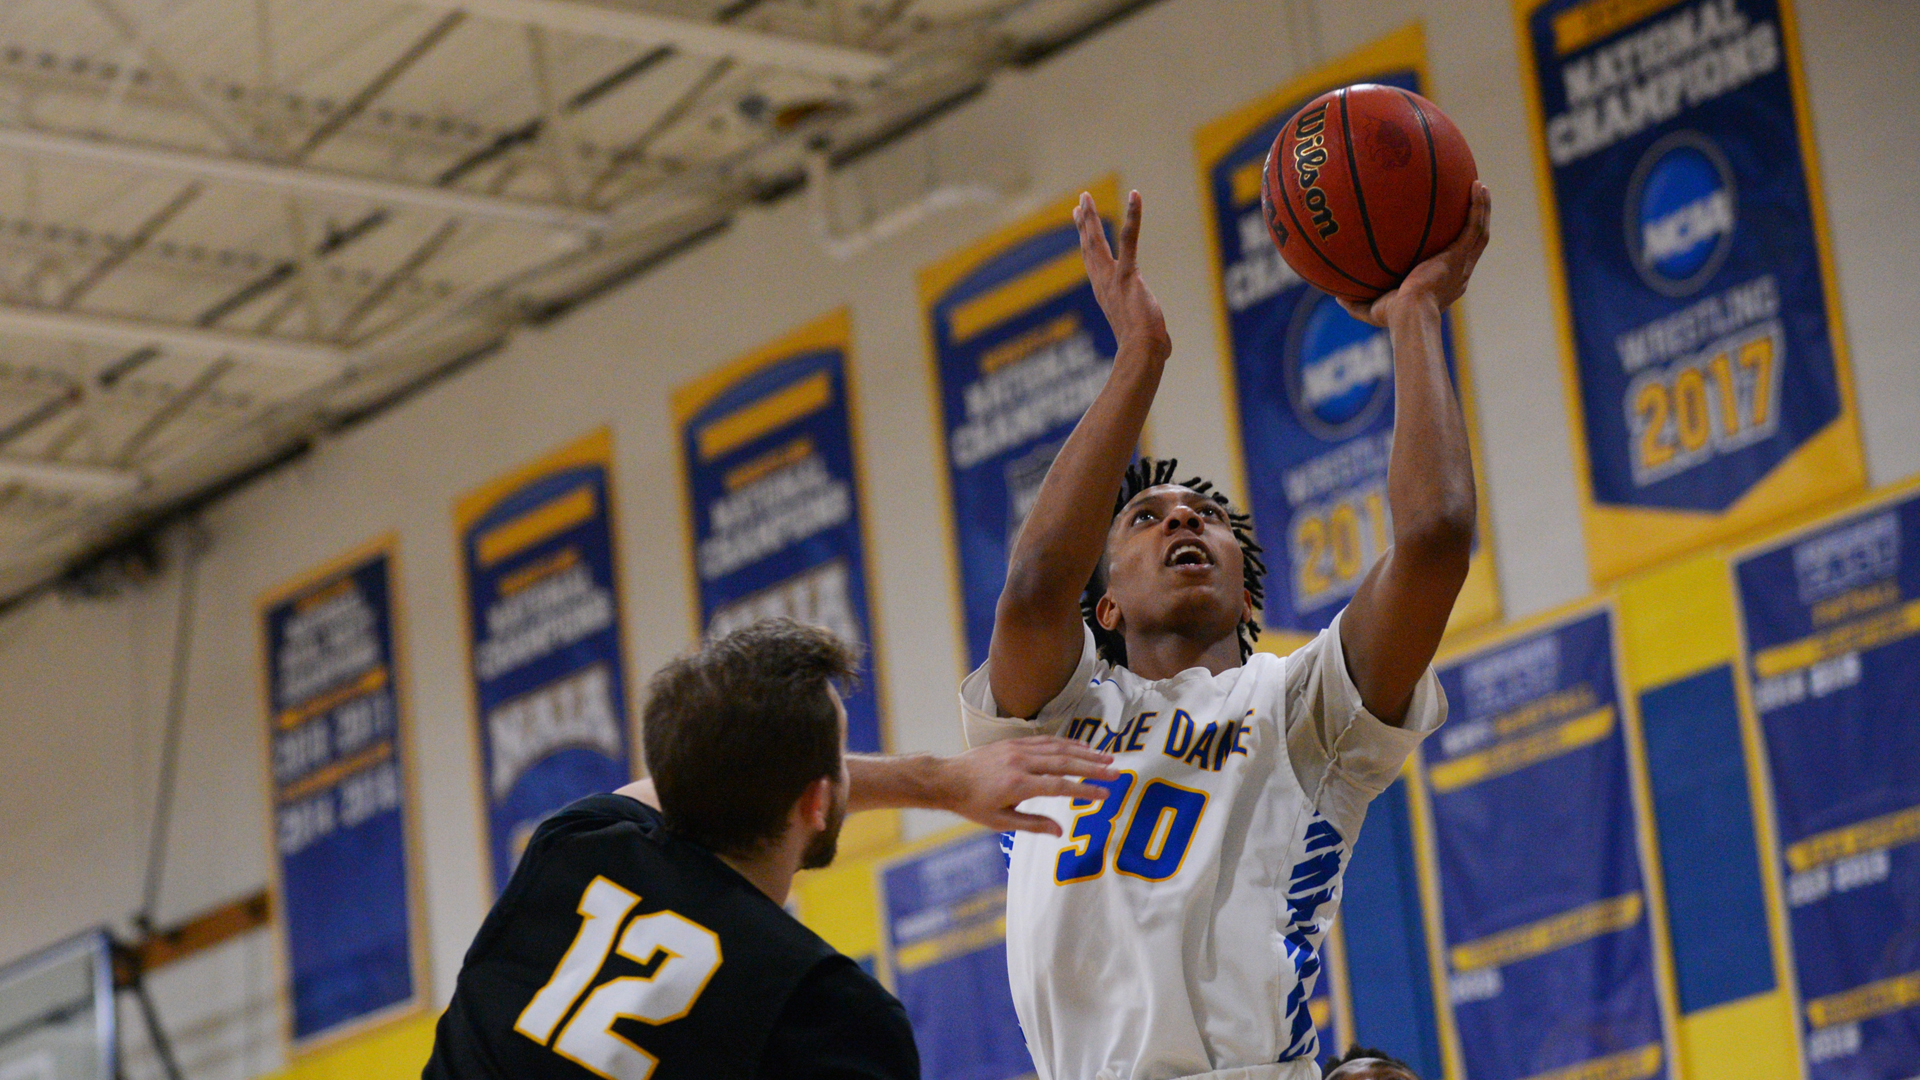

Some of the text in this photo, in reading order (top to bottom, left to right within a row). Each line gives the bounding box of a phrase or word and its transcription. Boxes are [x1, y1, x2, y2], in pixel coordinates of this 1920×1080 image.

[1547, 21, 1780, 166] CHAMPIONS
[1563, 0, 1748, 103] NATIONAL
[1294, 101, 1340, 242] Wilson
[1642, 187, 1735, 264] NCAA
[1628, 324, 1782, 480] 2017
[1295, 483, 1392, 605] 201
[1054, 769, 1210, 887] 30
[513, 874, 724, 1080] 12
